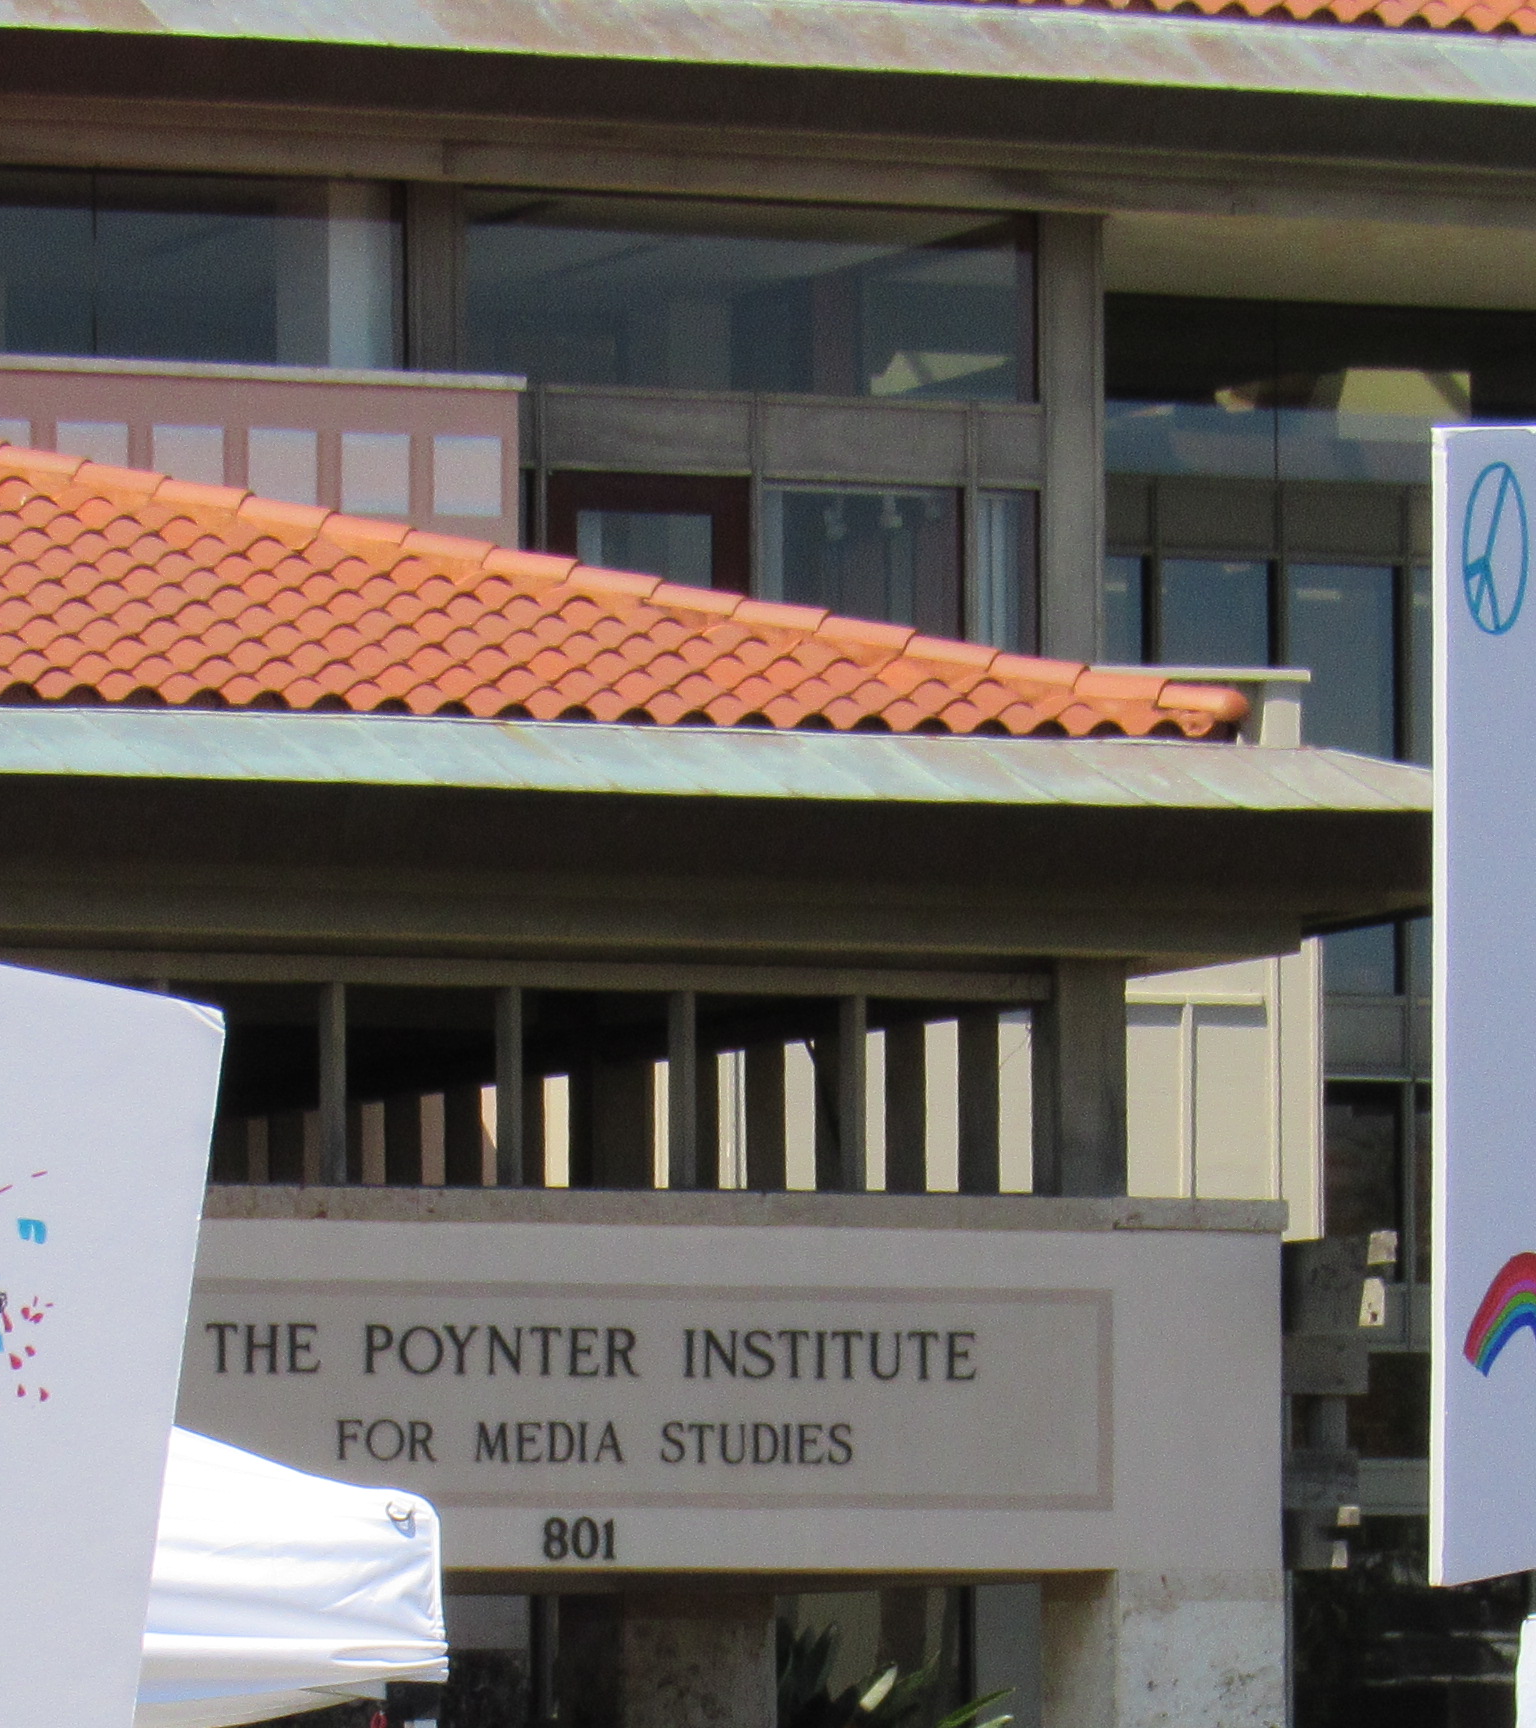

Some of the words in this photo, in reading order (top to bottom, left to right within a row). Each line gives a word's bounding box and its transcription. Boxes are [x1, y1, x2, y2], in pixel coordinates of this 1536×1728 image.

[204, 1322, 322, 1375] THE
[362, 1324, 640, 1380] POYNTER
[682, 1328, 980, 1383] INSTITUTE
[335, 1418, 438, 1465] FOR
[474, 1420, 625, 1466] MEDIA
[660, 1421, 856, 1468] STUDIES
[541, 1516, 619, 1562] 801
